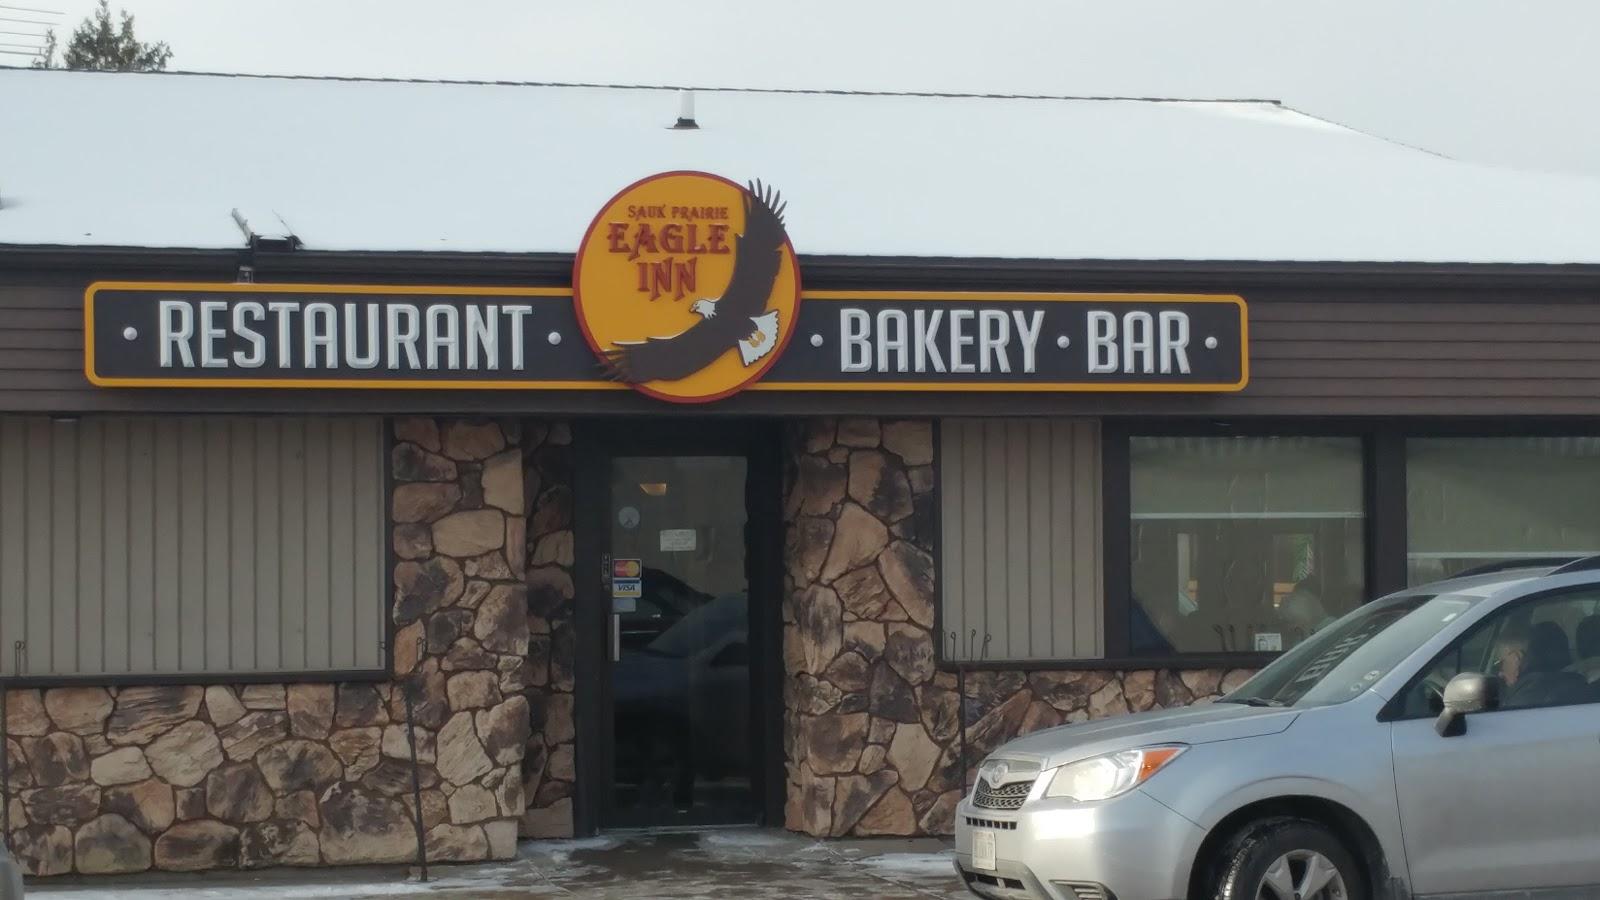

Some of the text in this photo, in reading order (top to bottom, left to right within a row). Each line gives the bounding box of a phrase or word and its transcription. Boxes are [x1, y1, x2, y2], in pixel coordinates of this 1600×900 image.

[628, 204, 728, 221] SAUK PRAIRIE
[607, 222, 730, 260] EAGLE
[637, 257, 698, 301] INN
[159, 300, 1191, 374] RESTAURANT BAKERY BAR
